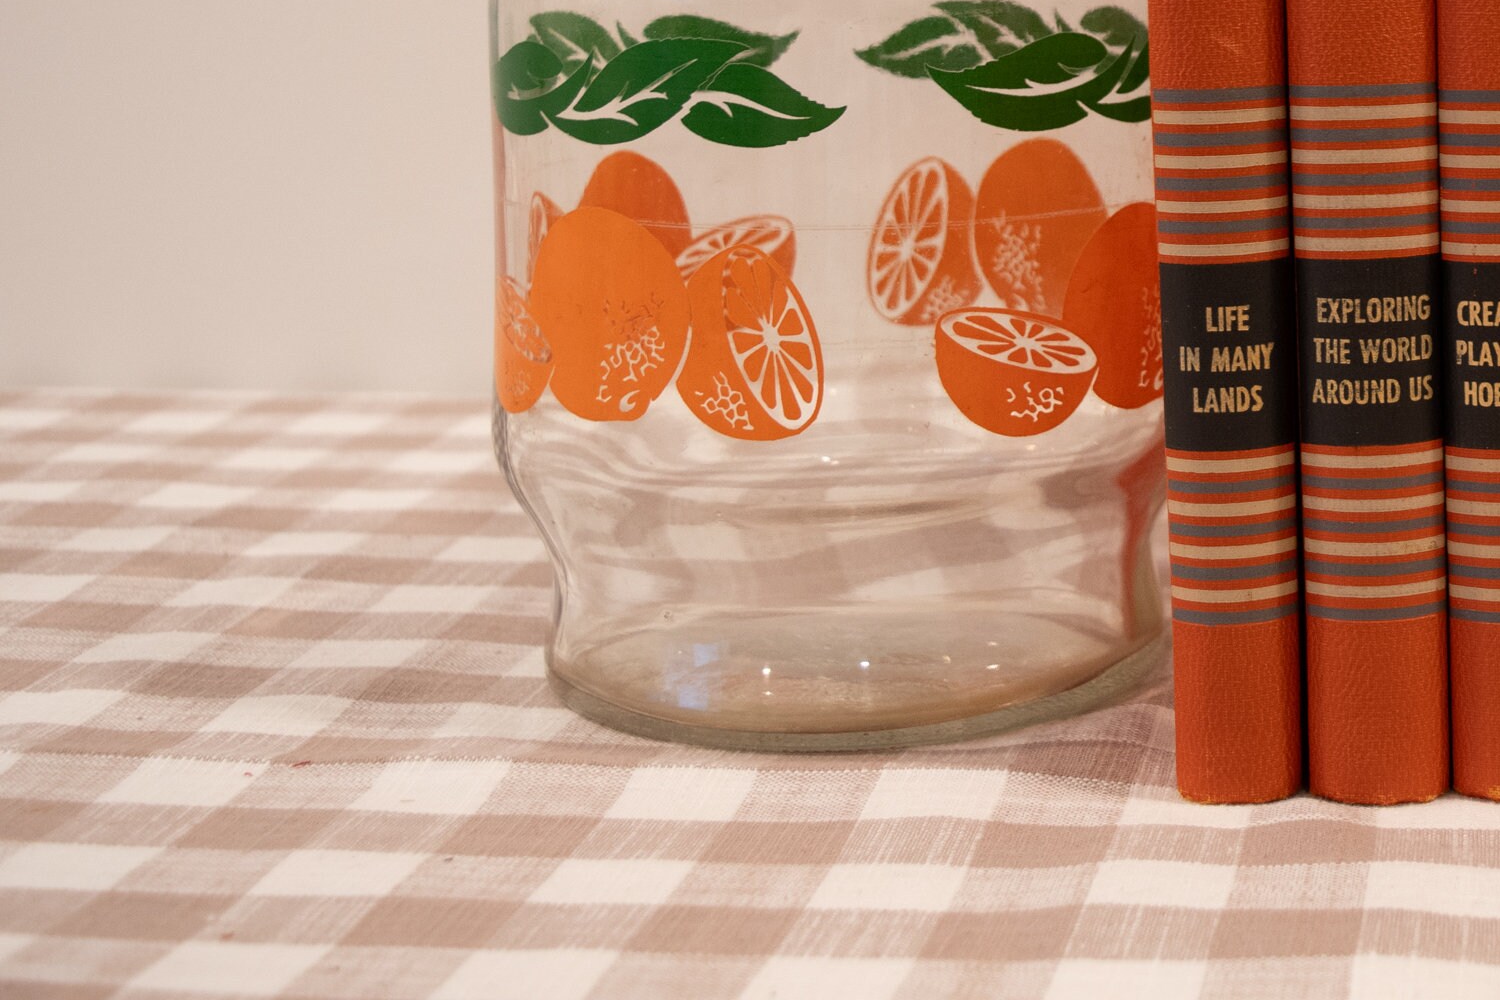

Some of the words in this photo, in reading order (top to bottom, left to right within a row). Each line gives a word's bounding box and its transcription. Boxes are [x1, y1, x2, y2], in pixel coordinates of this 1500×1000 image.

[1205, 304, 1250, 333] LIFE
[1316, 294, 1431, 324] EXPLORING
[1179, 346, 1201, 373] IN
[1210, 342, 1275, 373] MANY
[1313, 337, 1351, 365] THE
[1358, 333, 1433, 365] WORLD
[1192, 384, 1264, 414] LANDS
[1312, 378, 1400, 405] AROUND
[1409, 375, 1434, 402] US
